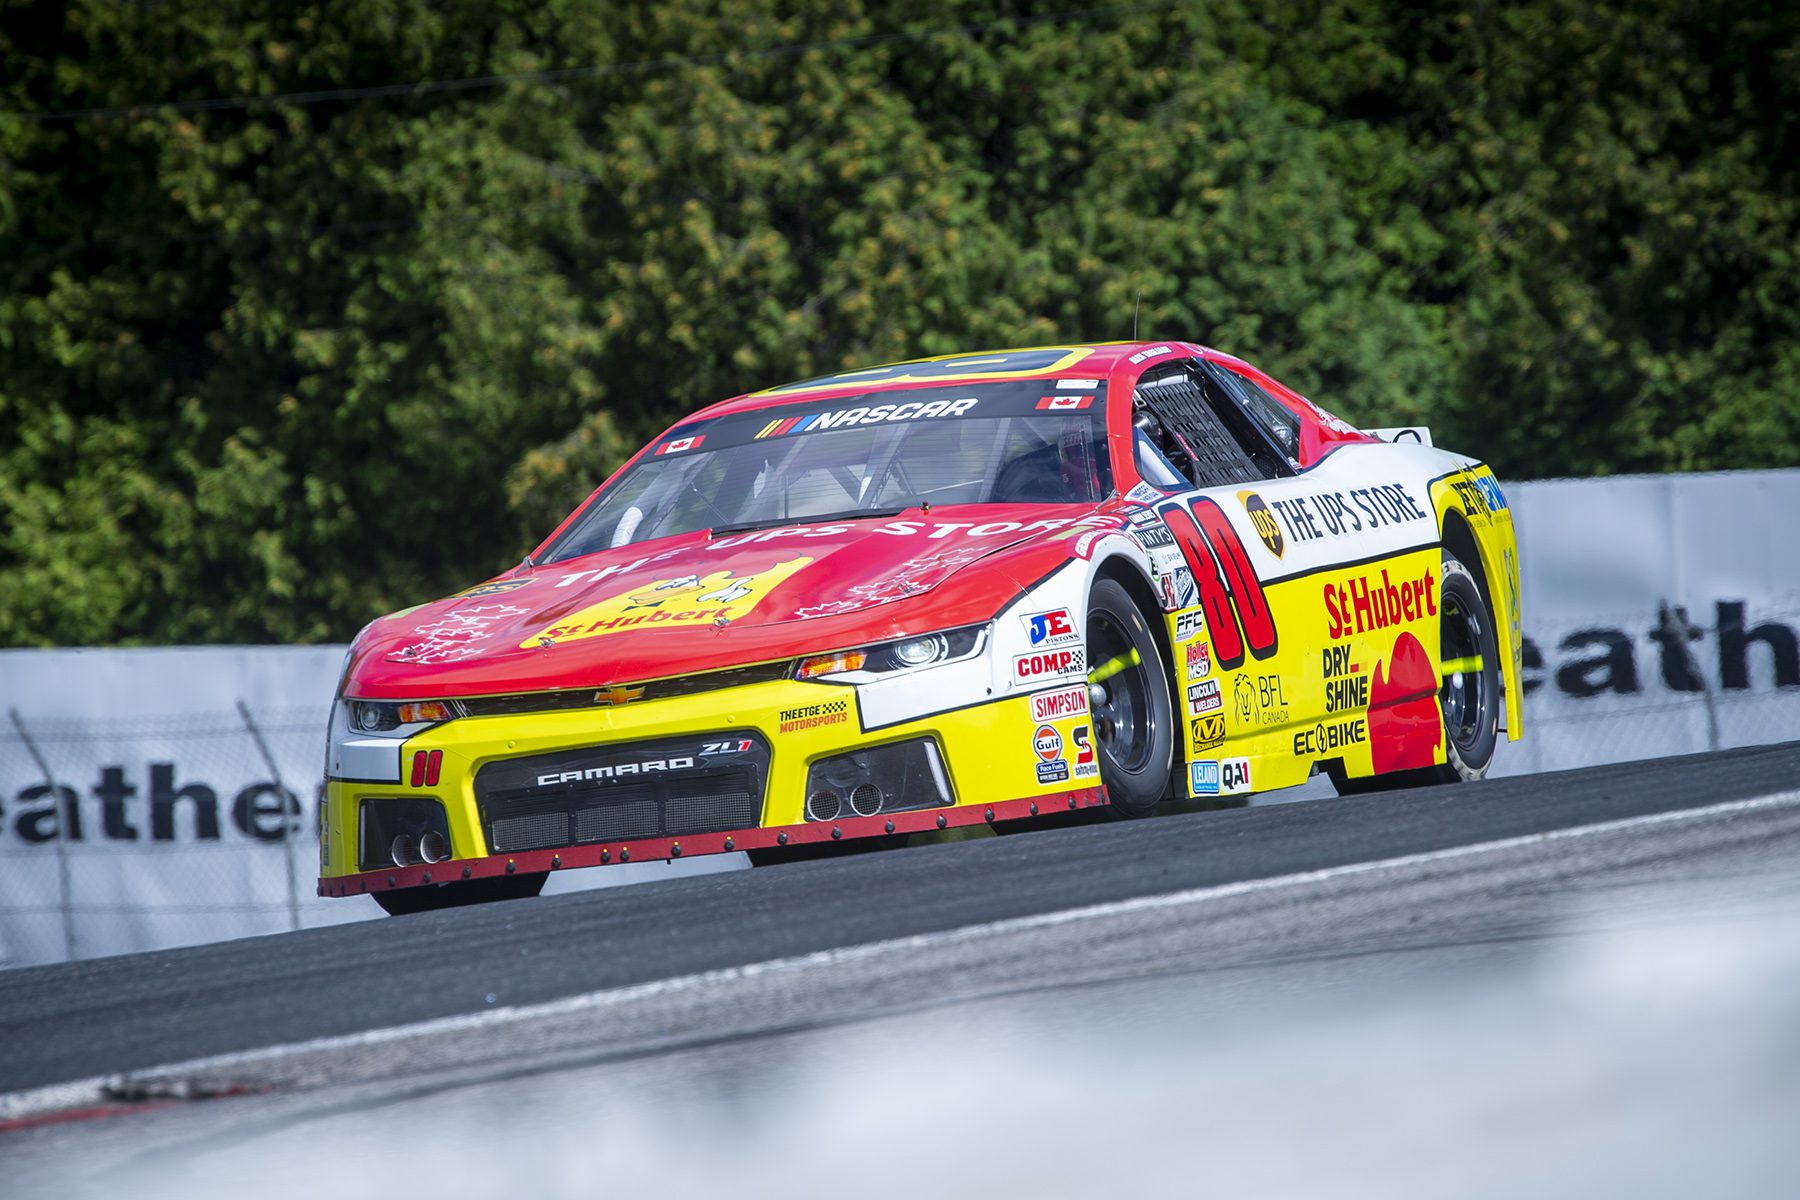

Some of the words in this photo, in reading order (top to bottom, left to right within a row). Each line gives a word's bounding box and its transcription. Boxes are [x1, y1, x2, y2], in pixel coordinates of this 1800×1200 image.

[804, 398, 979, 432] NASCAR
[1271, 497, 1323, 542] THE
[1310, 491, 1362, 535] UPS
[1350, 483, 1427, 528] STORE
[706, 522, 857, 550] UPS
[872, 514, 1124, 539] STORE
[1135, 526, 1172, 548] PINTY'S
[1249, 508, 1280, 549] ups
[1158, 495, 1279, 672] 80
[1323, 582, 1353, 640] St
[1348, 566, 1437, 634] Hubert
[546, 622, 585, 641] St
[583, 605, 736, 636] Hubert
[1030, 610, 1072, 645] JE
[1176, 610, 1202, 633] PFC
[1045, 634, 1080, 645] PISTONS
[1017, 651, 1072, 677] COMP
[1057, 663, 1083, 675] CAMS
[1188, 660, 1211, 681] MSD
[1036, 690, 1086, 719] SIMPSON
[1188, 681, 1216, 701] LINCOLN
[1195, 696, 1220, 712] WELDERS
[1258, 674, 1289, 708] BFL
[1325, 675, 1369, 713] SHINE
[779, 704, 821, 722] THEETGE
[779, 711, 848, 734] MOTORSPORTS
[1262, 711, 1290, 725] CANADA
[699, 739, 753, 757] ZL1
[1036, 737, 1061, 751] Gulf
[410, 749, 444, 788] 80
[537, 757, 694, 787] CAMARO
[1222, 761, 1249, 790] QA1
